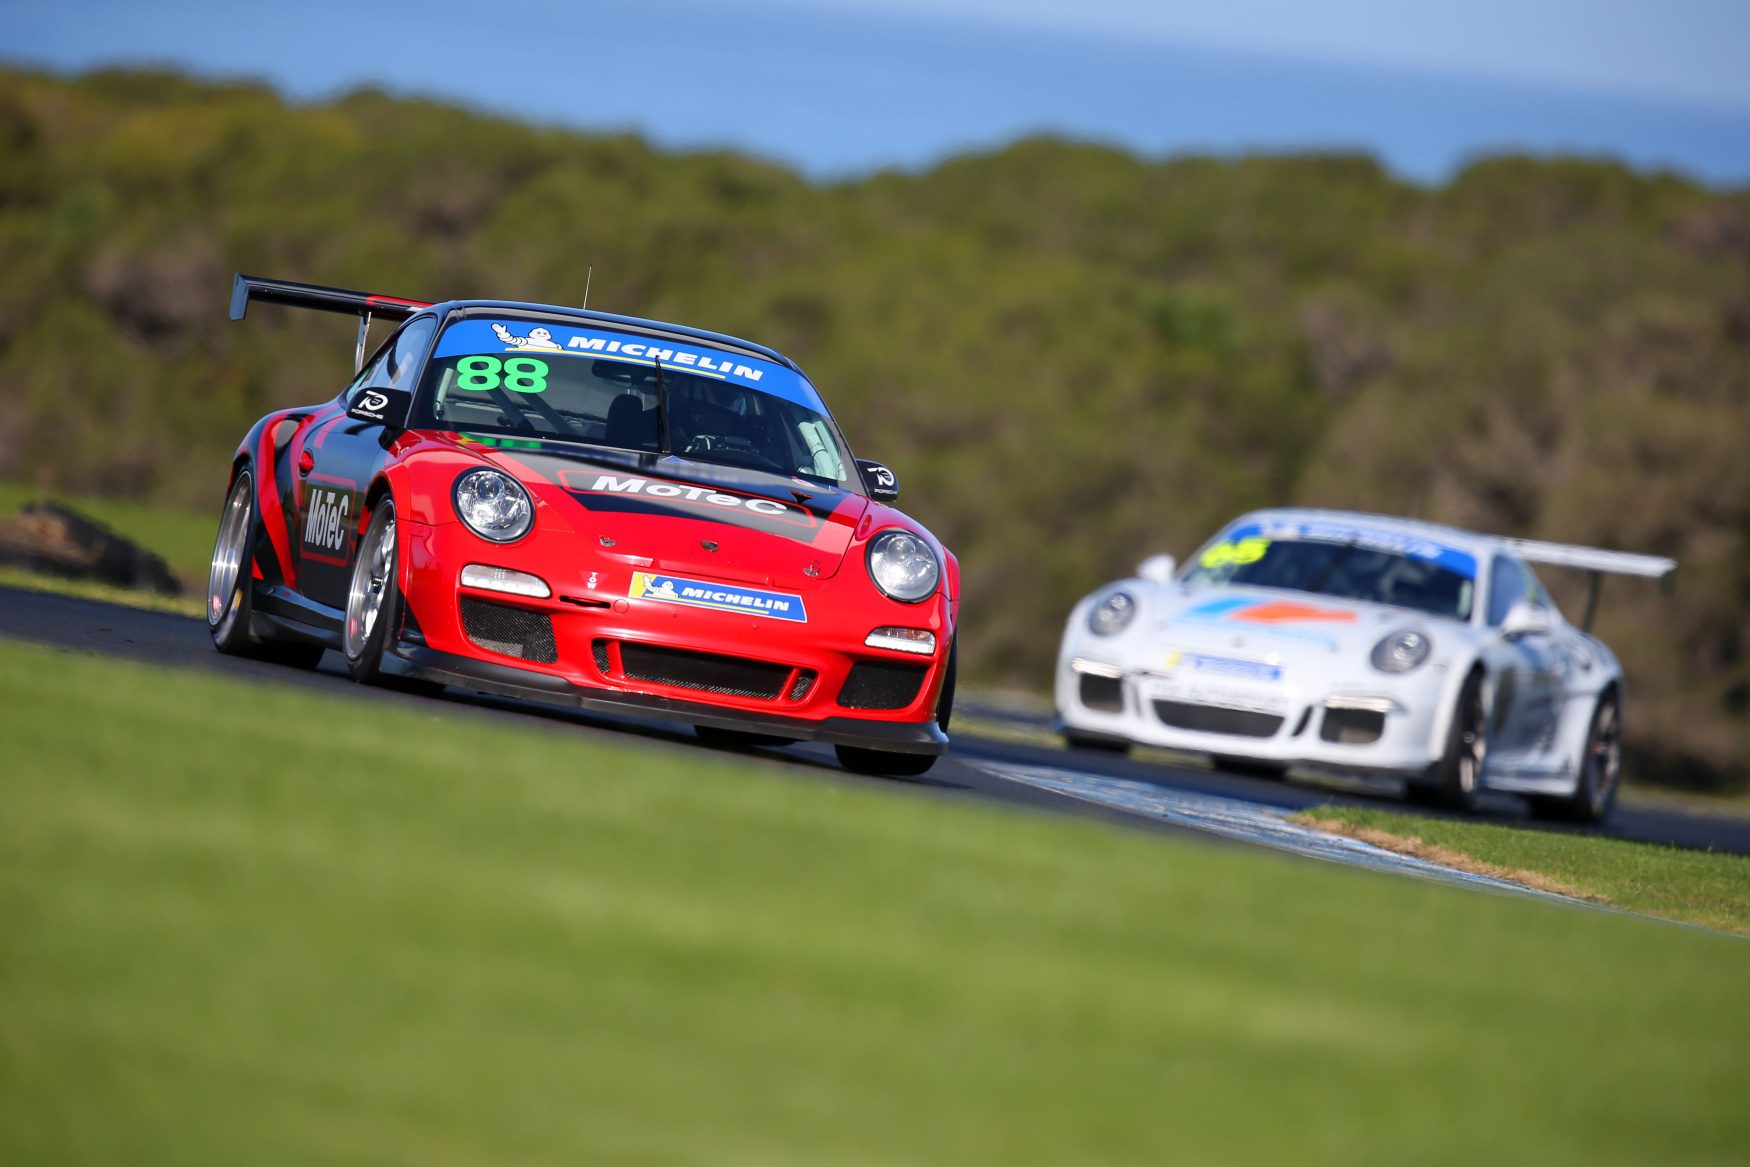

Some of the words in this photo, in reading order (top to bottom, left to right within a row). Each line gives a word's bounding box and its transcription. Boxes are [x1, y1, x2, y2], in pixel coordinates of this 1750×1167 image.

[456, 355, 549, 394] 88
[567, 335, 765, 382] MICHELIN
[591, 475, 787, 516] MoTeC
[304, 488, 349, 551] MoTeC
[681, 586, 789, 613] MICHELIN
